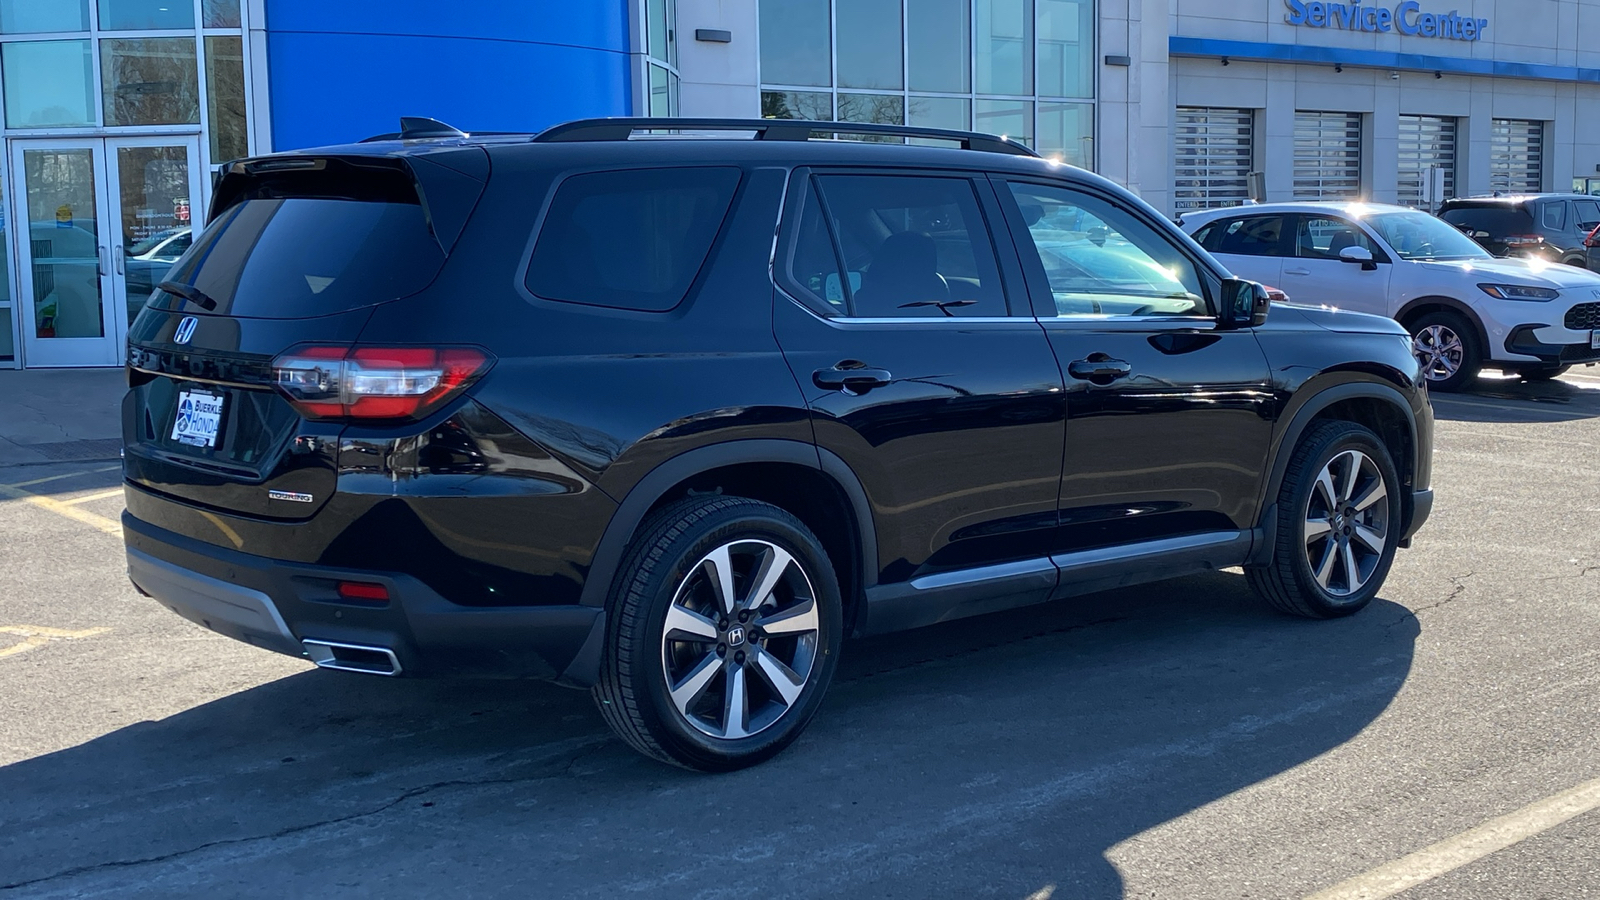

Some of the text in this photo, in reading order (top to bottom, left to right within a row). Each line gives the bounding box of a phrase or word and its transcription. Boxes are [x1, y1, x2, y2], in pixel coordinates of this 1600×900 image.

[1285, 0, 1488, 41] Service Center
[194, 400, 223, 415] BUERKLE
[190, 412, 219, 434] HONDA
